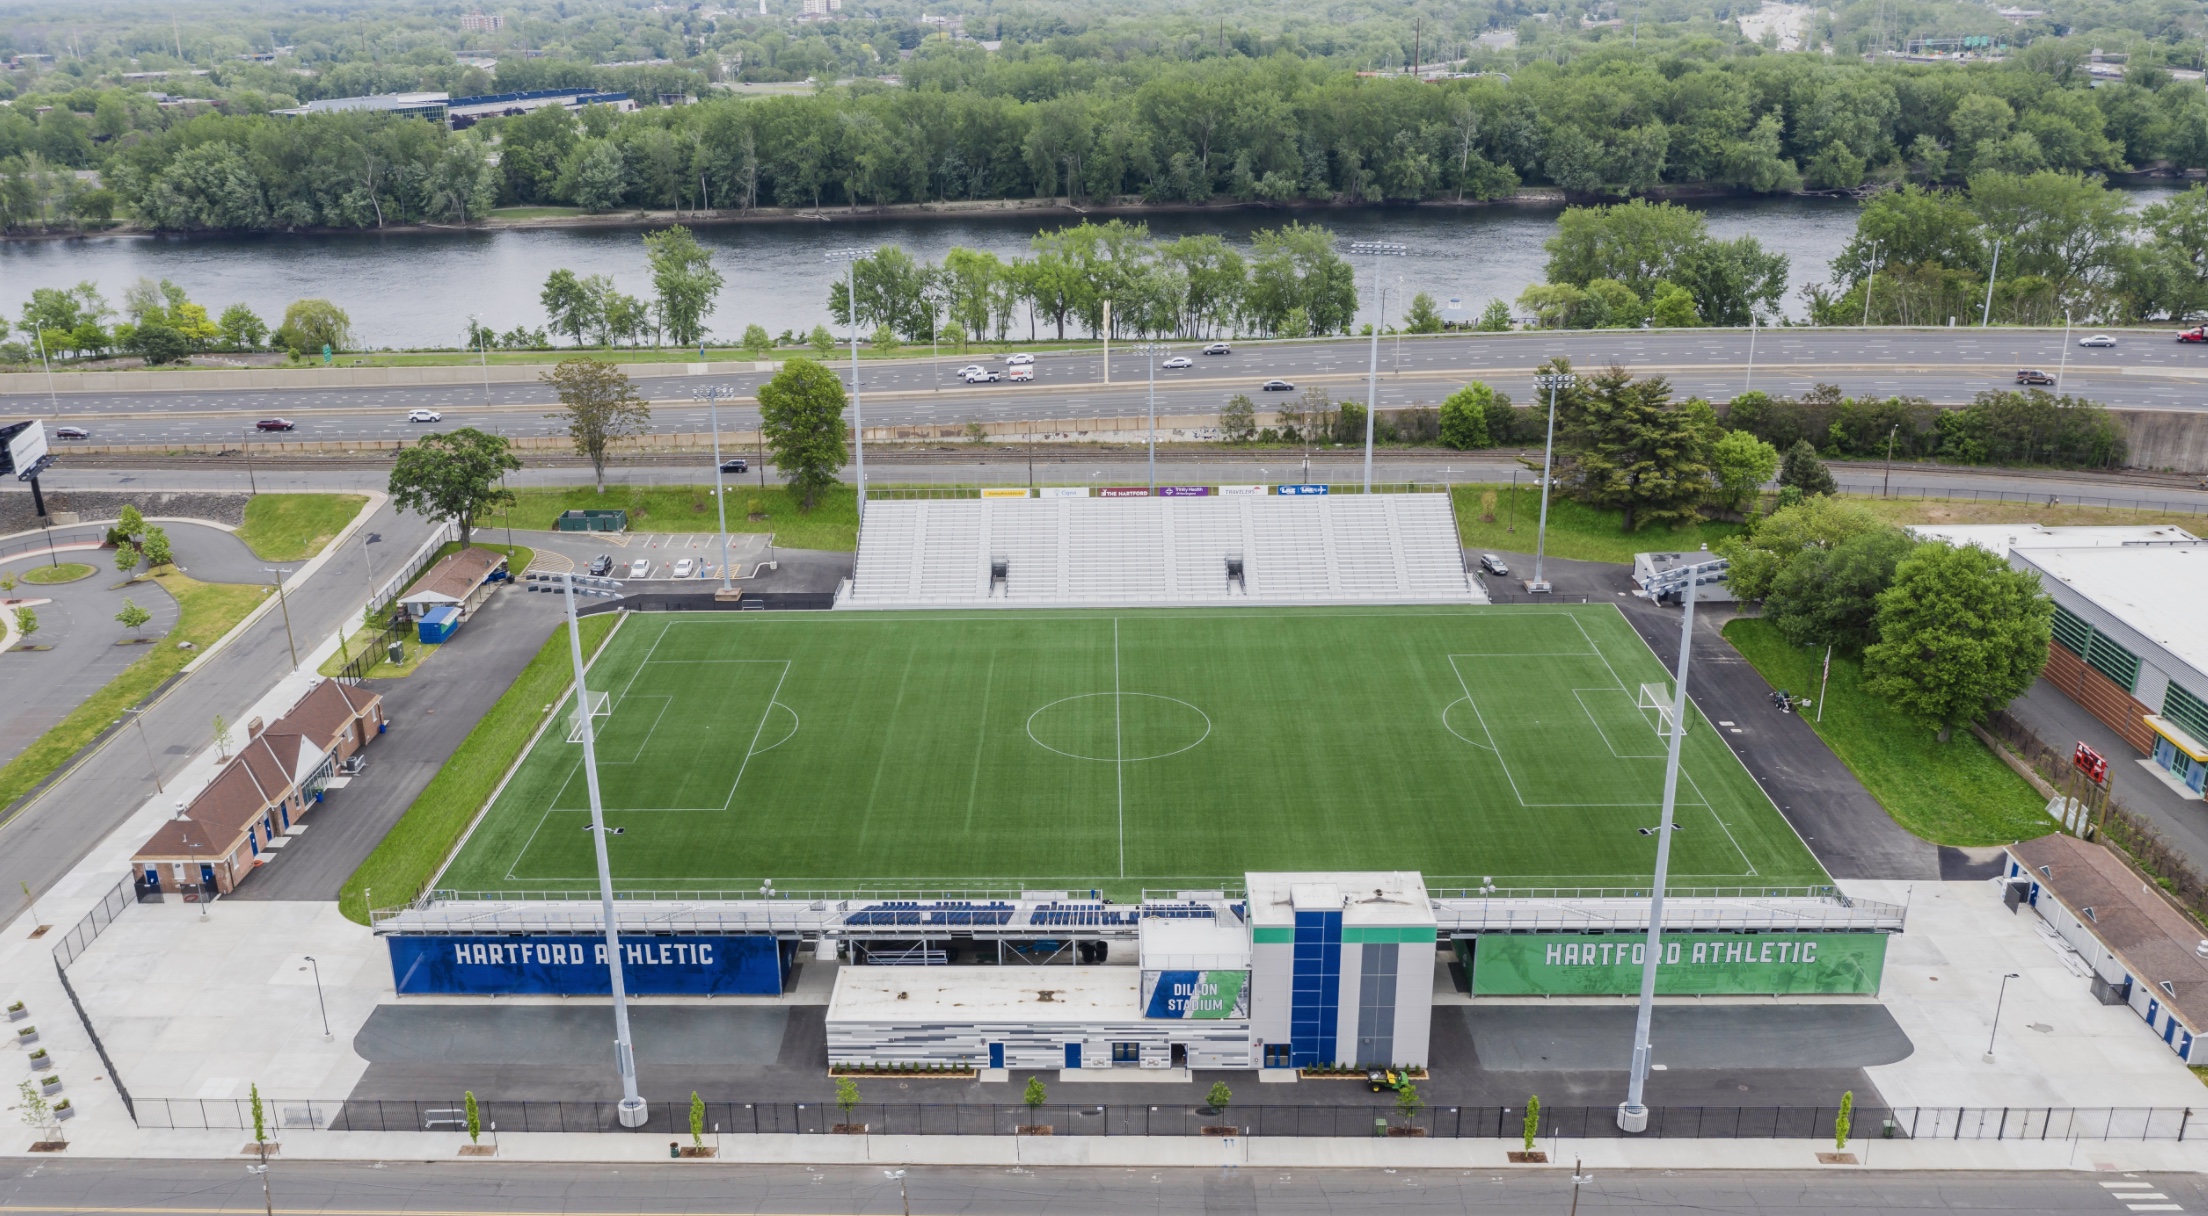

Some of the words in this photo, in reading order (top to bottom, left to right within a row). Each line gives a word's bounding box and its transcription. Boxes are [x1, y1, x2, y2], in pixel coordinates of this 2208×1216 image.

[454, 943, 585, 965] HARTFORD
[594, 943, 714, 965] AHLETIC
[1690, 941, 1818, 964] ATHLETIC
[1173, 983, 1218, 996] DILLON
[1167, 998, 1223, 1011] STADIUM
